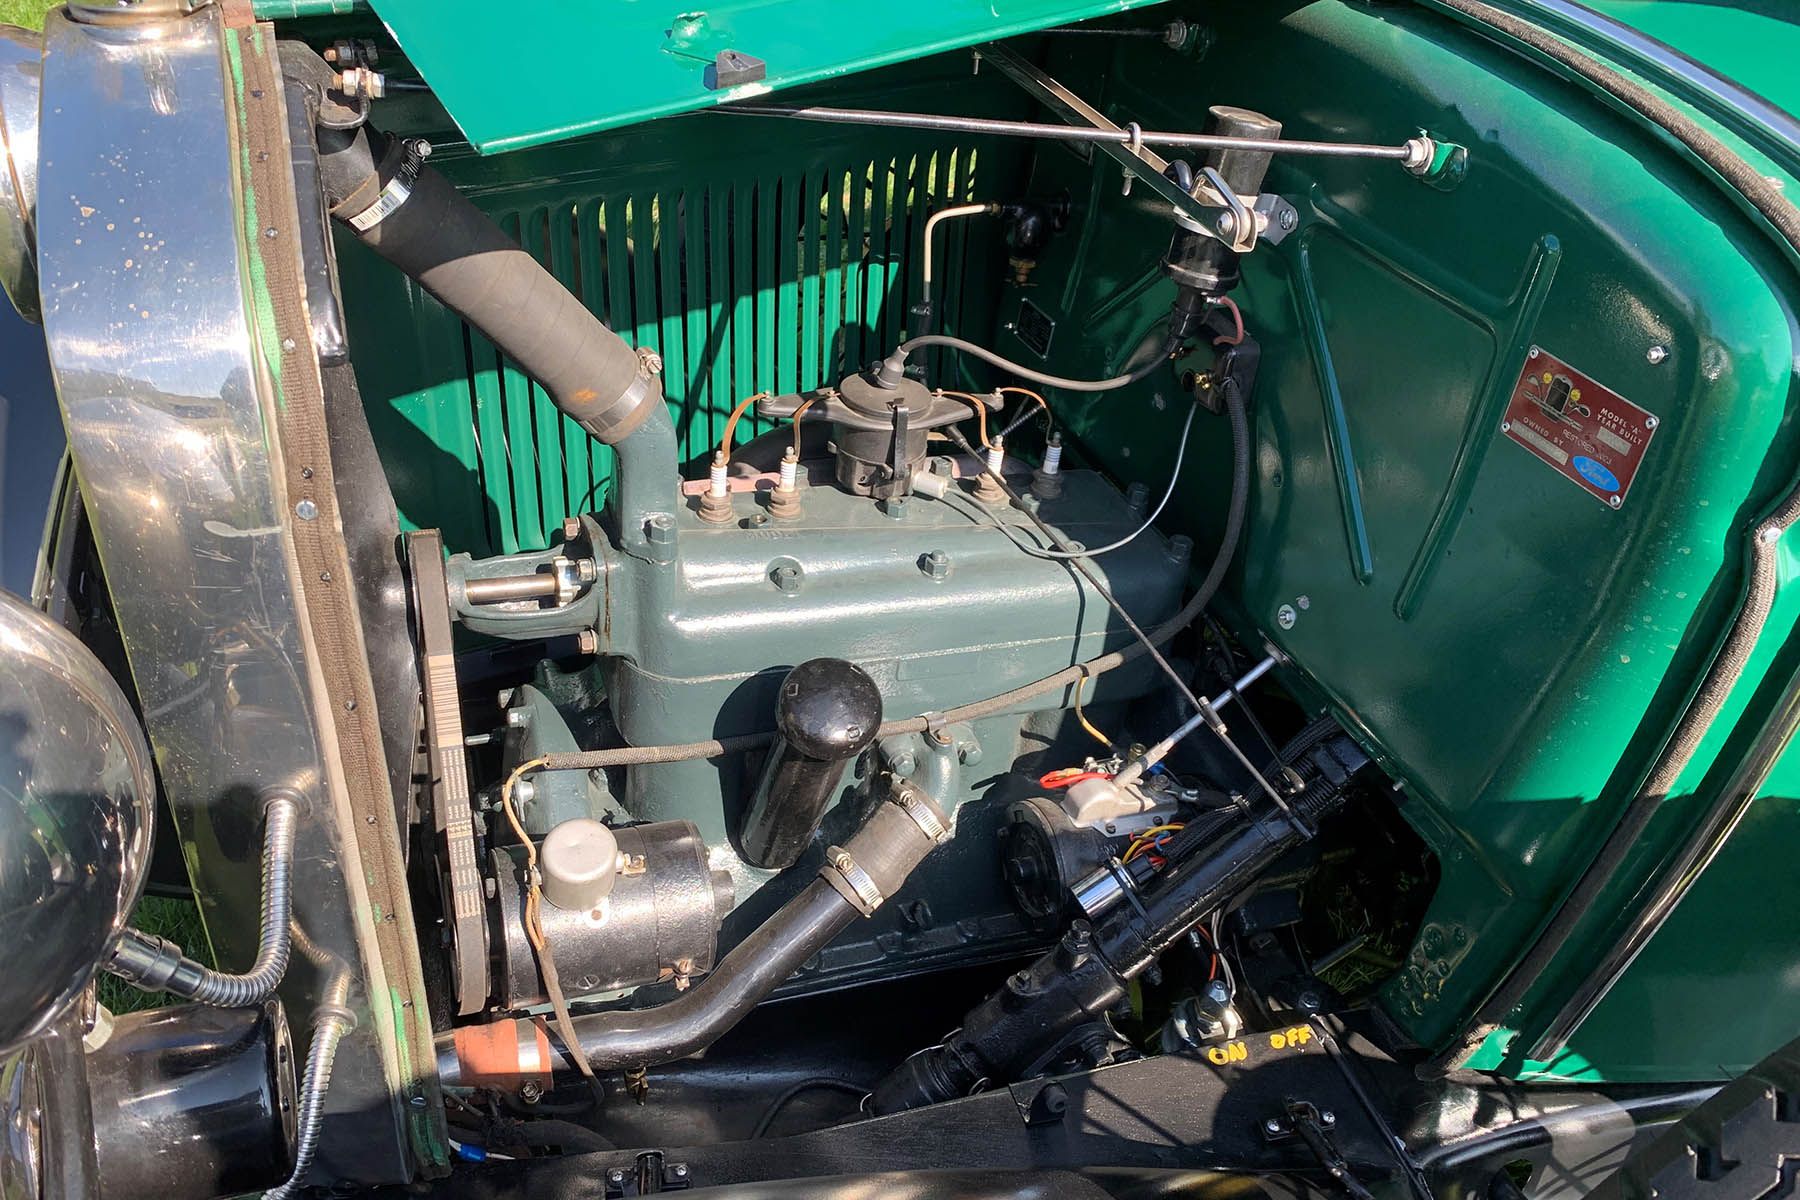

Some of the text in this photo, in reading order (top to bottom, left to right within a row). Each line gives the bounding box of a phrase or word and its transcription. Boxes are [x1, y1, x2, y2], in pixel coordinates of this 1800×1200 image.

[1523, 416, 1564, 447] OWNED BY
[1597, 414, 1617, 430] YEAR
[1619, 428, 1642, 445] BUILT
[1600, 408, 1627, 428] MODEL
[1562, 429, 1595, 454] RESTORED
[1208, 1026, 1311, 1065] ON OFF
